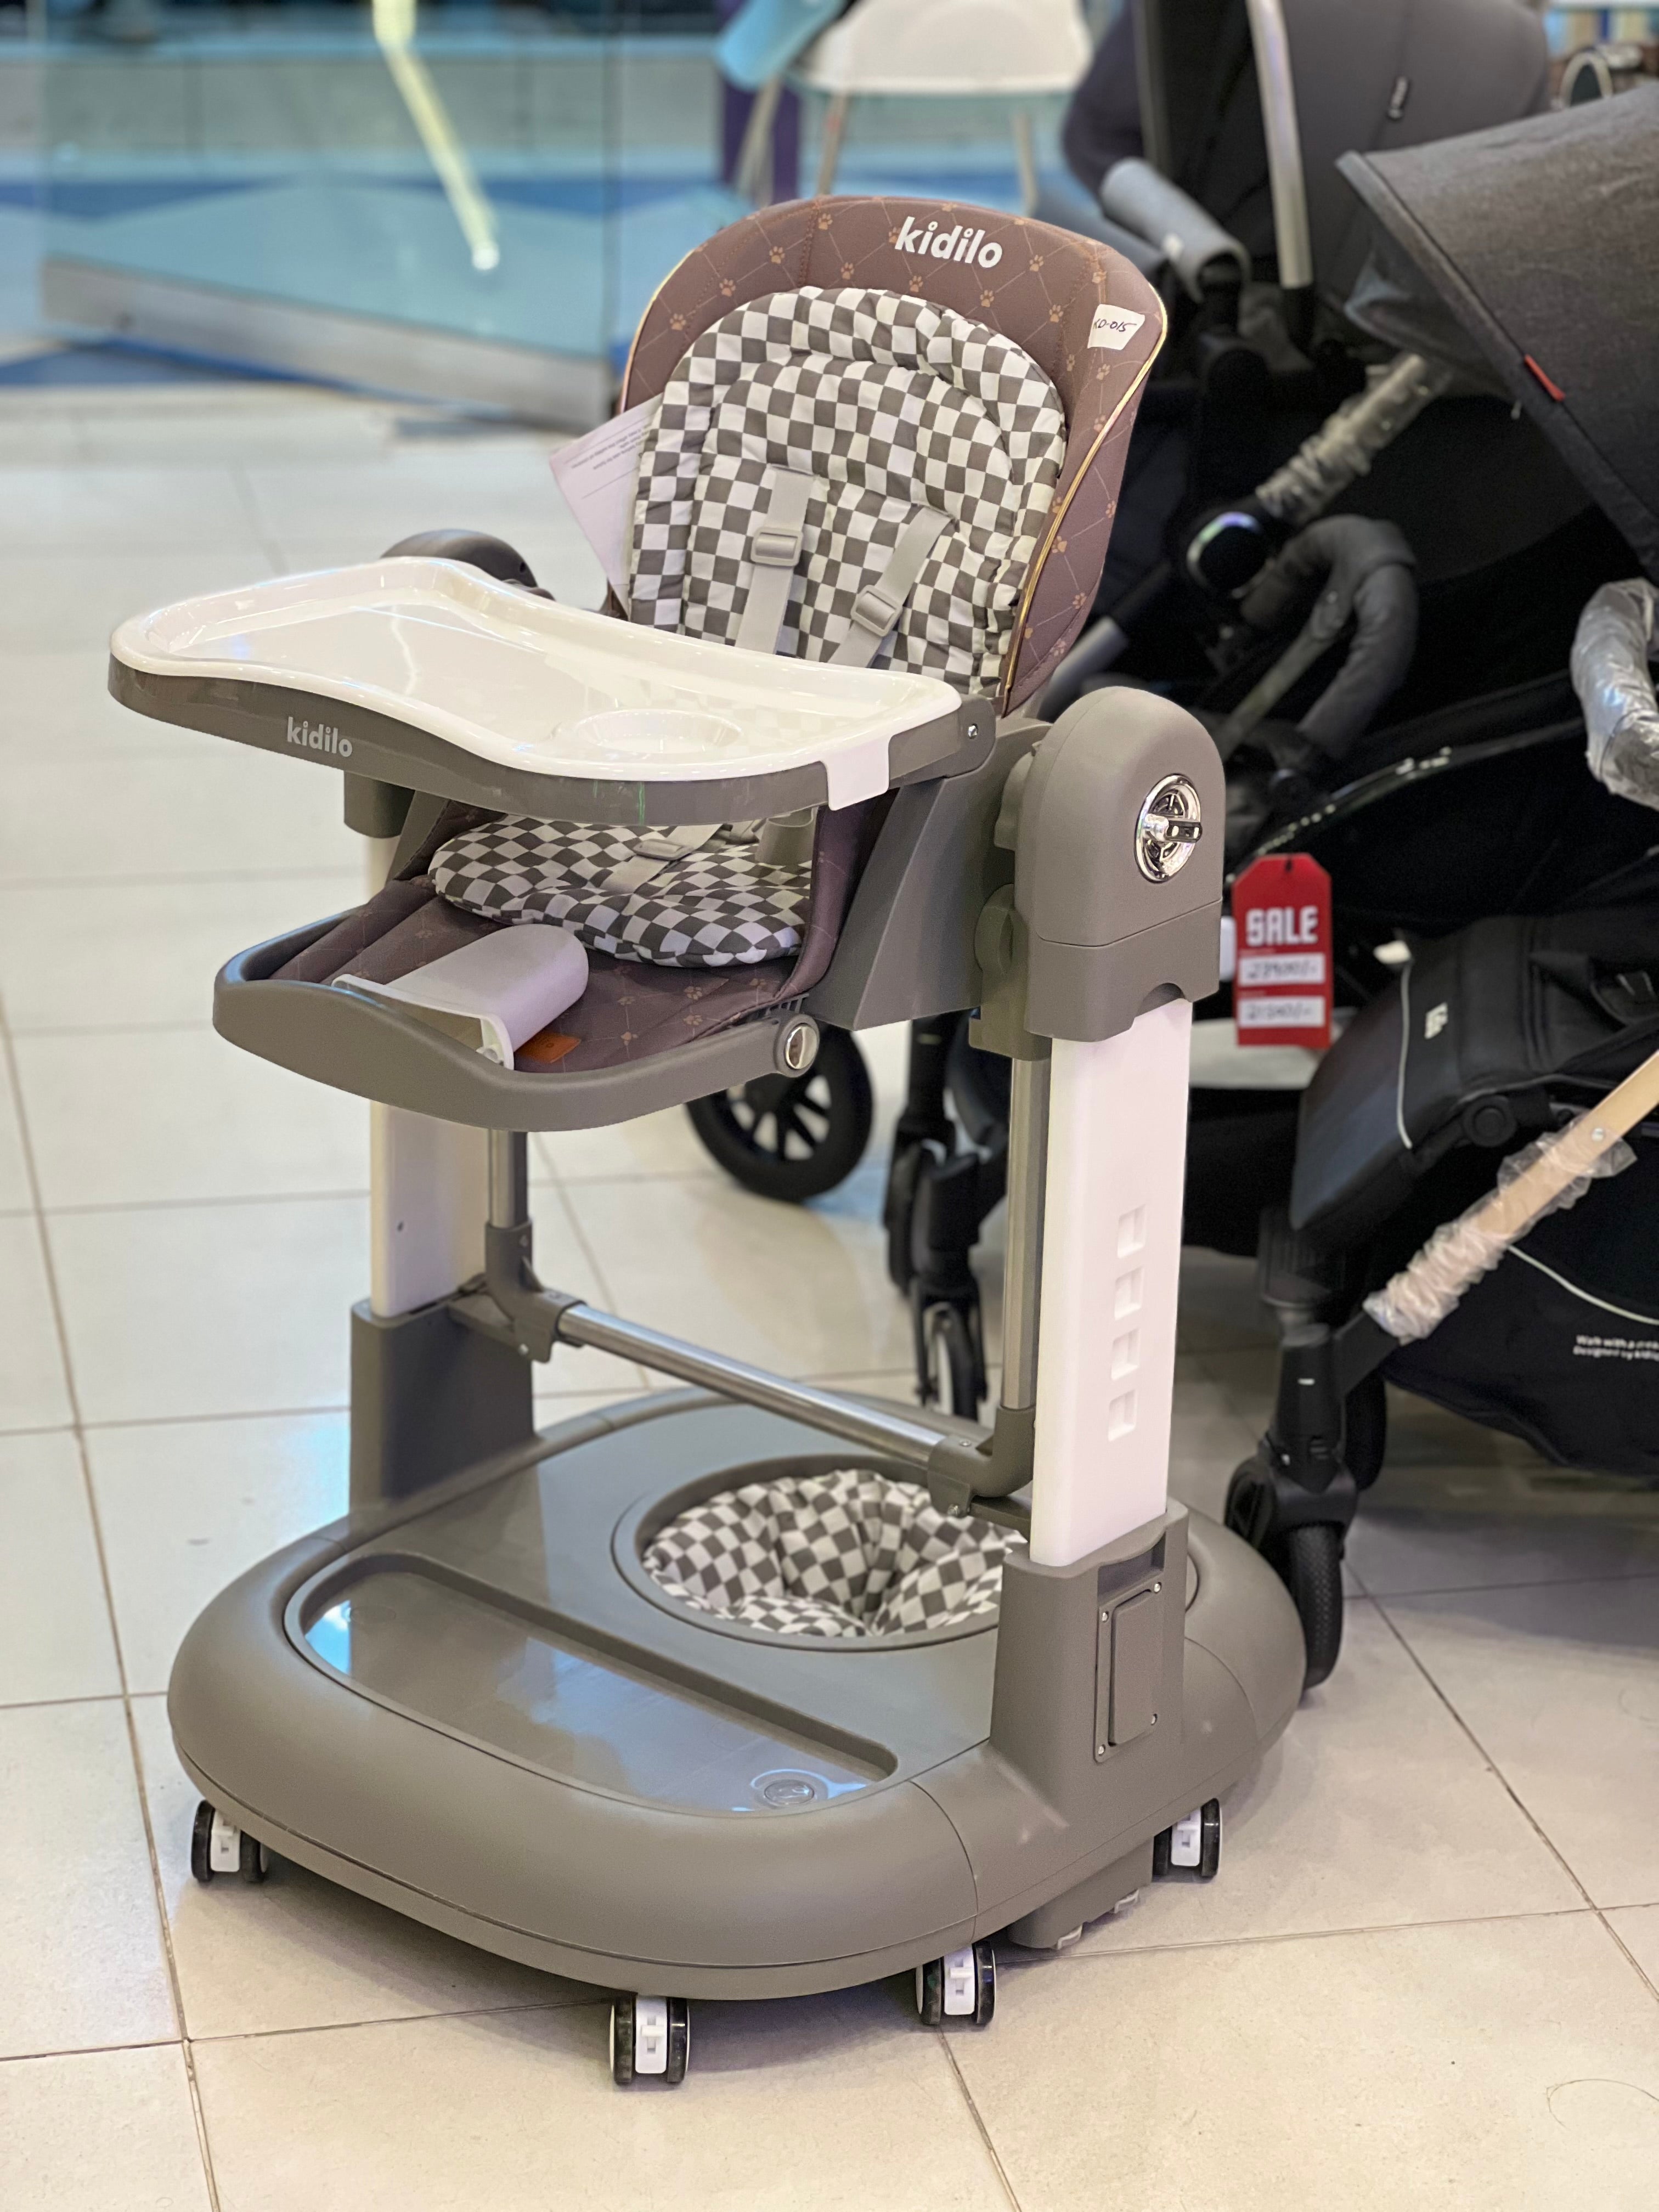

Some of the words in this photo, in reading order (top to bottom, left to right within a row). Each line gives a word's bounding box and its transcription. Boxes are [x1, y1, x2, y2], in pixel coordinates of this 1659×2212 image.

[895, 216, 1003, 268] kidilo
[287, 716, 353, 757] kidilo
[1246, 905, 1319, 946] SALE
